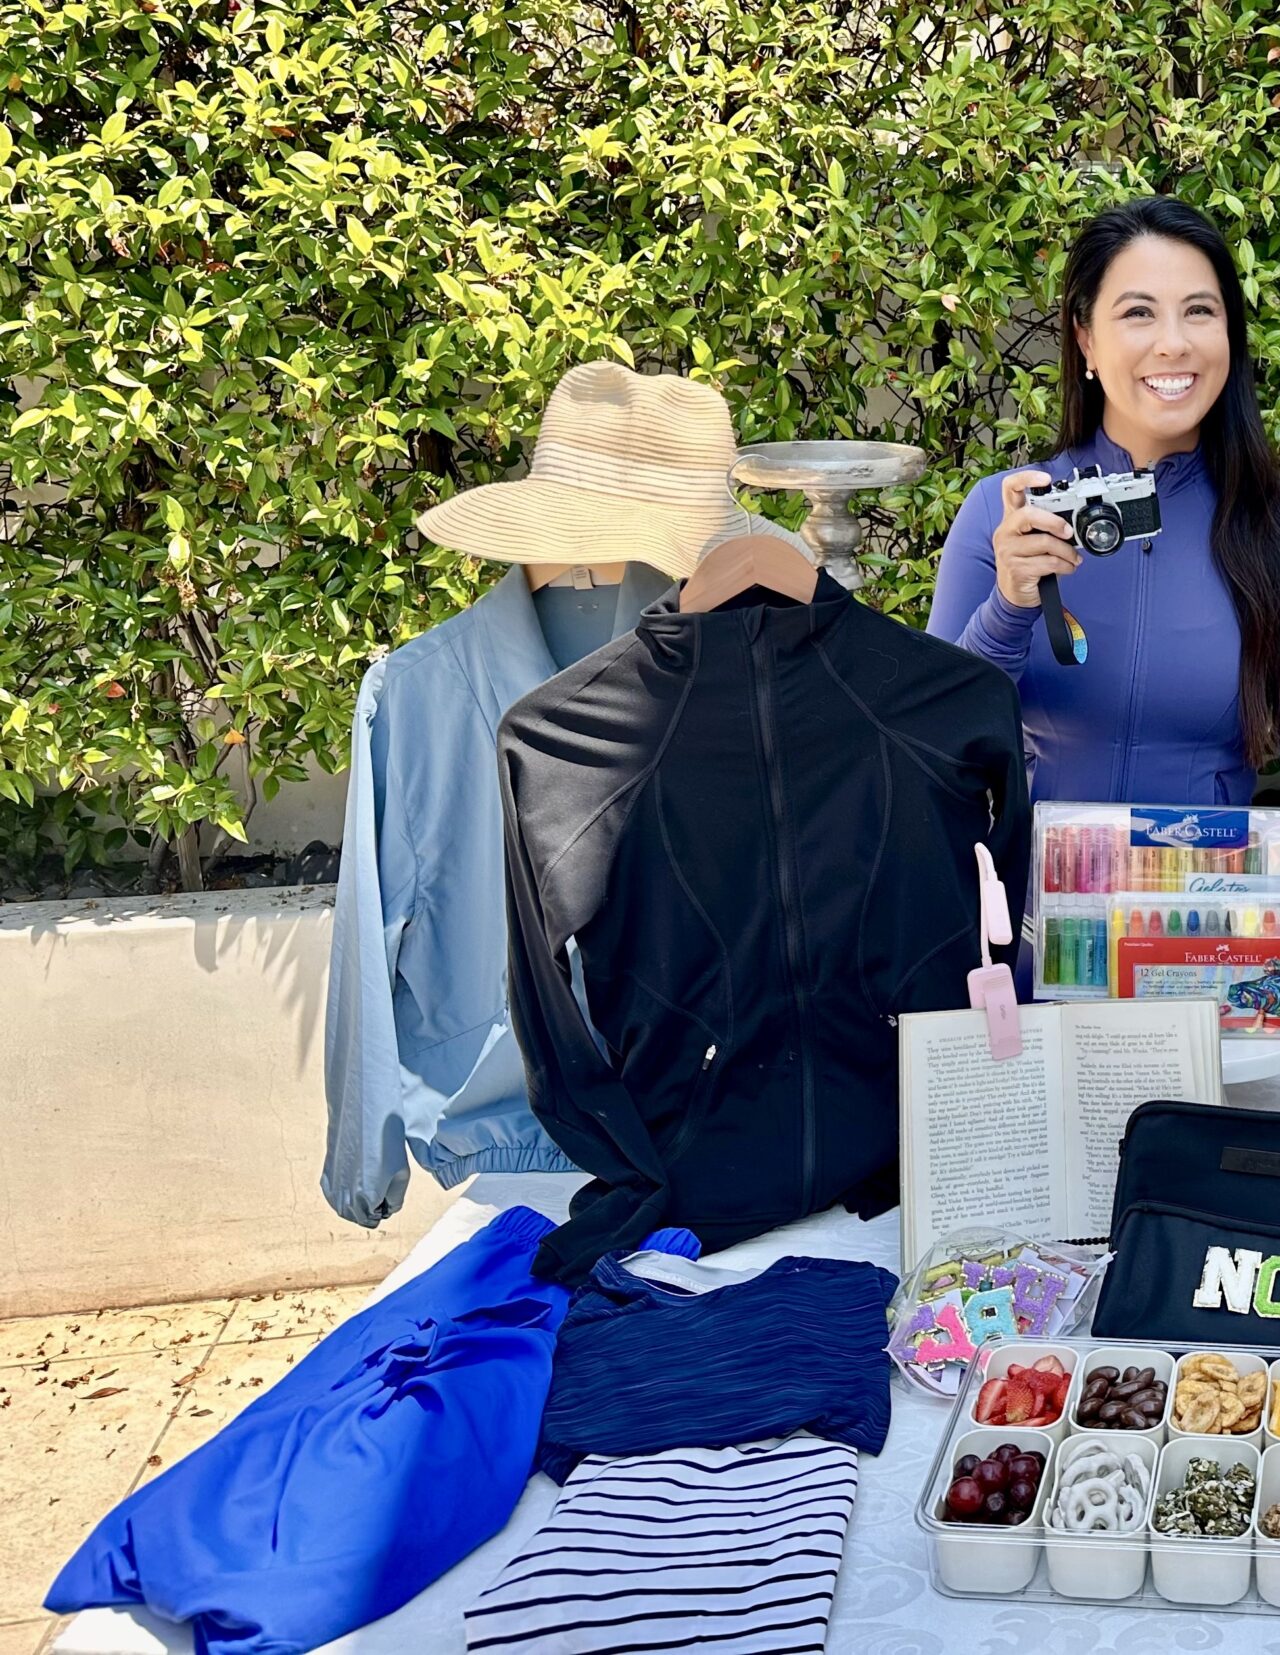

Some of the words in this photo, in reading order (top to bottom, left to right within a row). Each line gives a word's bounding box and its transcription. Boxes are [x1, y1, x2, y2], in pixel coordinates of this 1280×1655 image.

[1185, 952, 1261, 963] FABER-CASTELL
[1140, 968, 1149, 976] 12
[1151, 969, 1165, 977] Gel
[1166, 970, 1198, 979] Crayons
